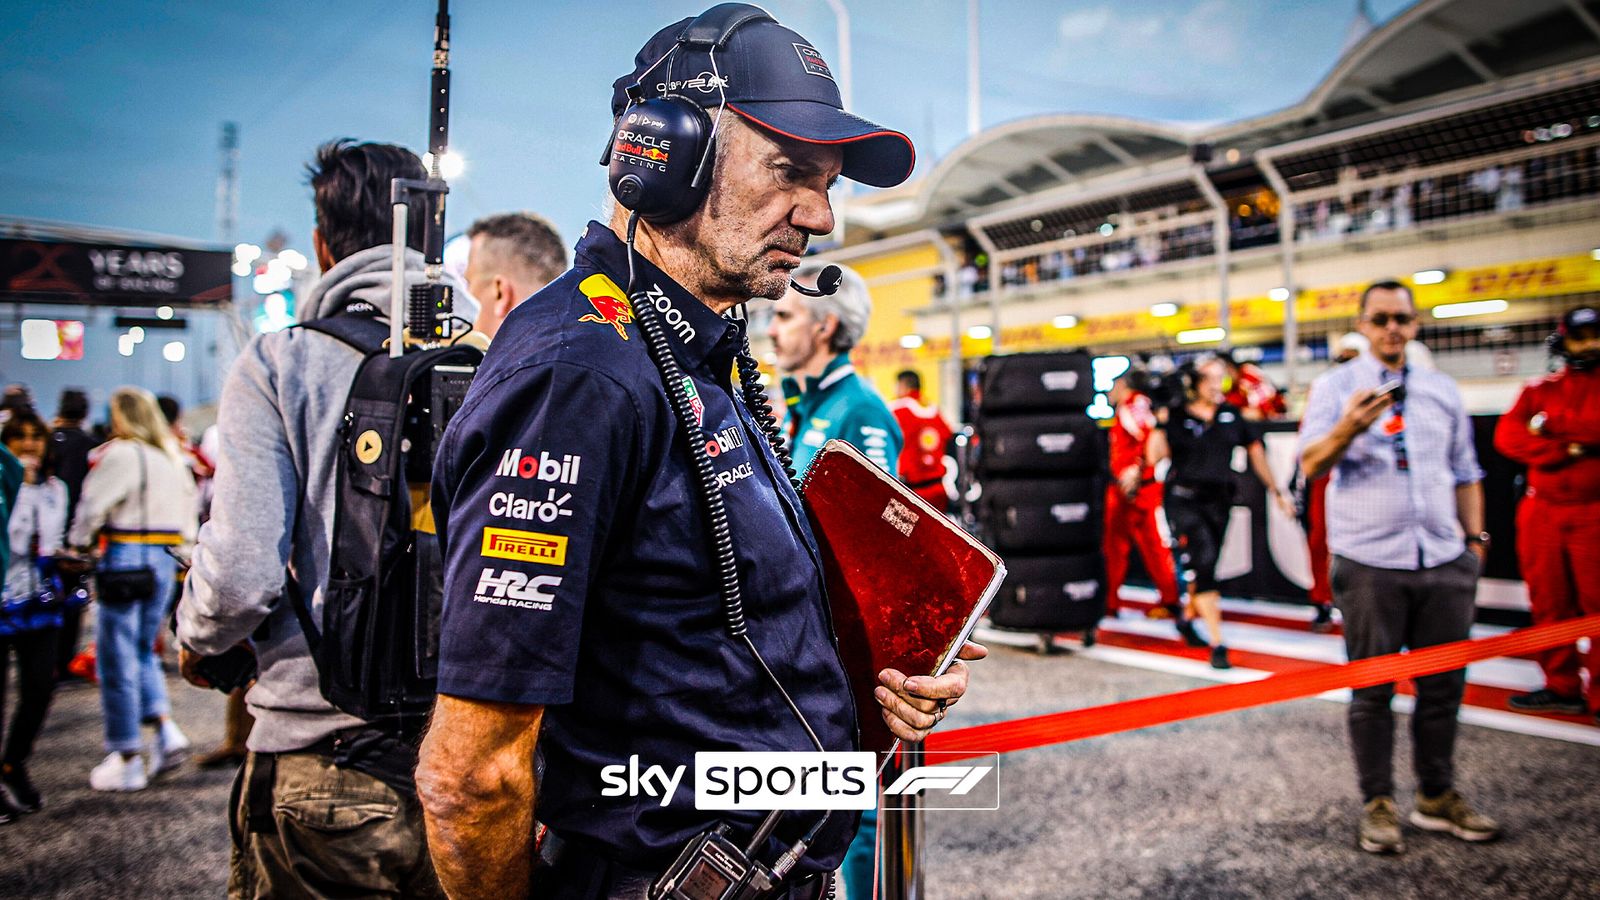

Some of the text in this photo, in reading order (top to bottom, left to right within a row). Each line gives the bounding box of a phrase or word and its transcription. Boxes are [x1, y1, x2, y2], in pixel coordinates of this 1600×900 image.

[617, 130, 671, 150] ORACLE
[612, 153, 667, 172] RACING
[88, 249, 185, 279] YEARS
[646, 283, 696, 344] zoom
[704, 430, 735, 458] obil
[495, 448, 581, 485] Mobil
[489, 488, 572, 523] Claro
[489, 534, 558, 559] PIRELLI
[474, 567, 563, 603] HRC
[473, 594, 553, 611] Honda RACING
